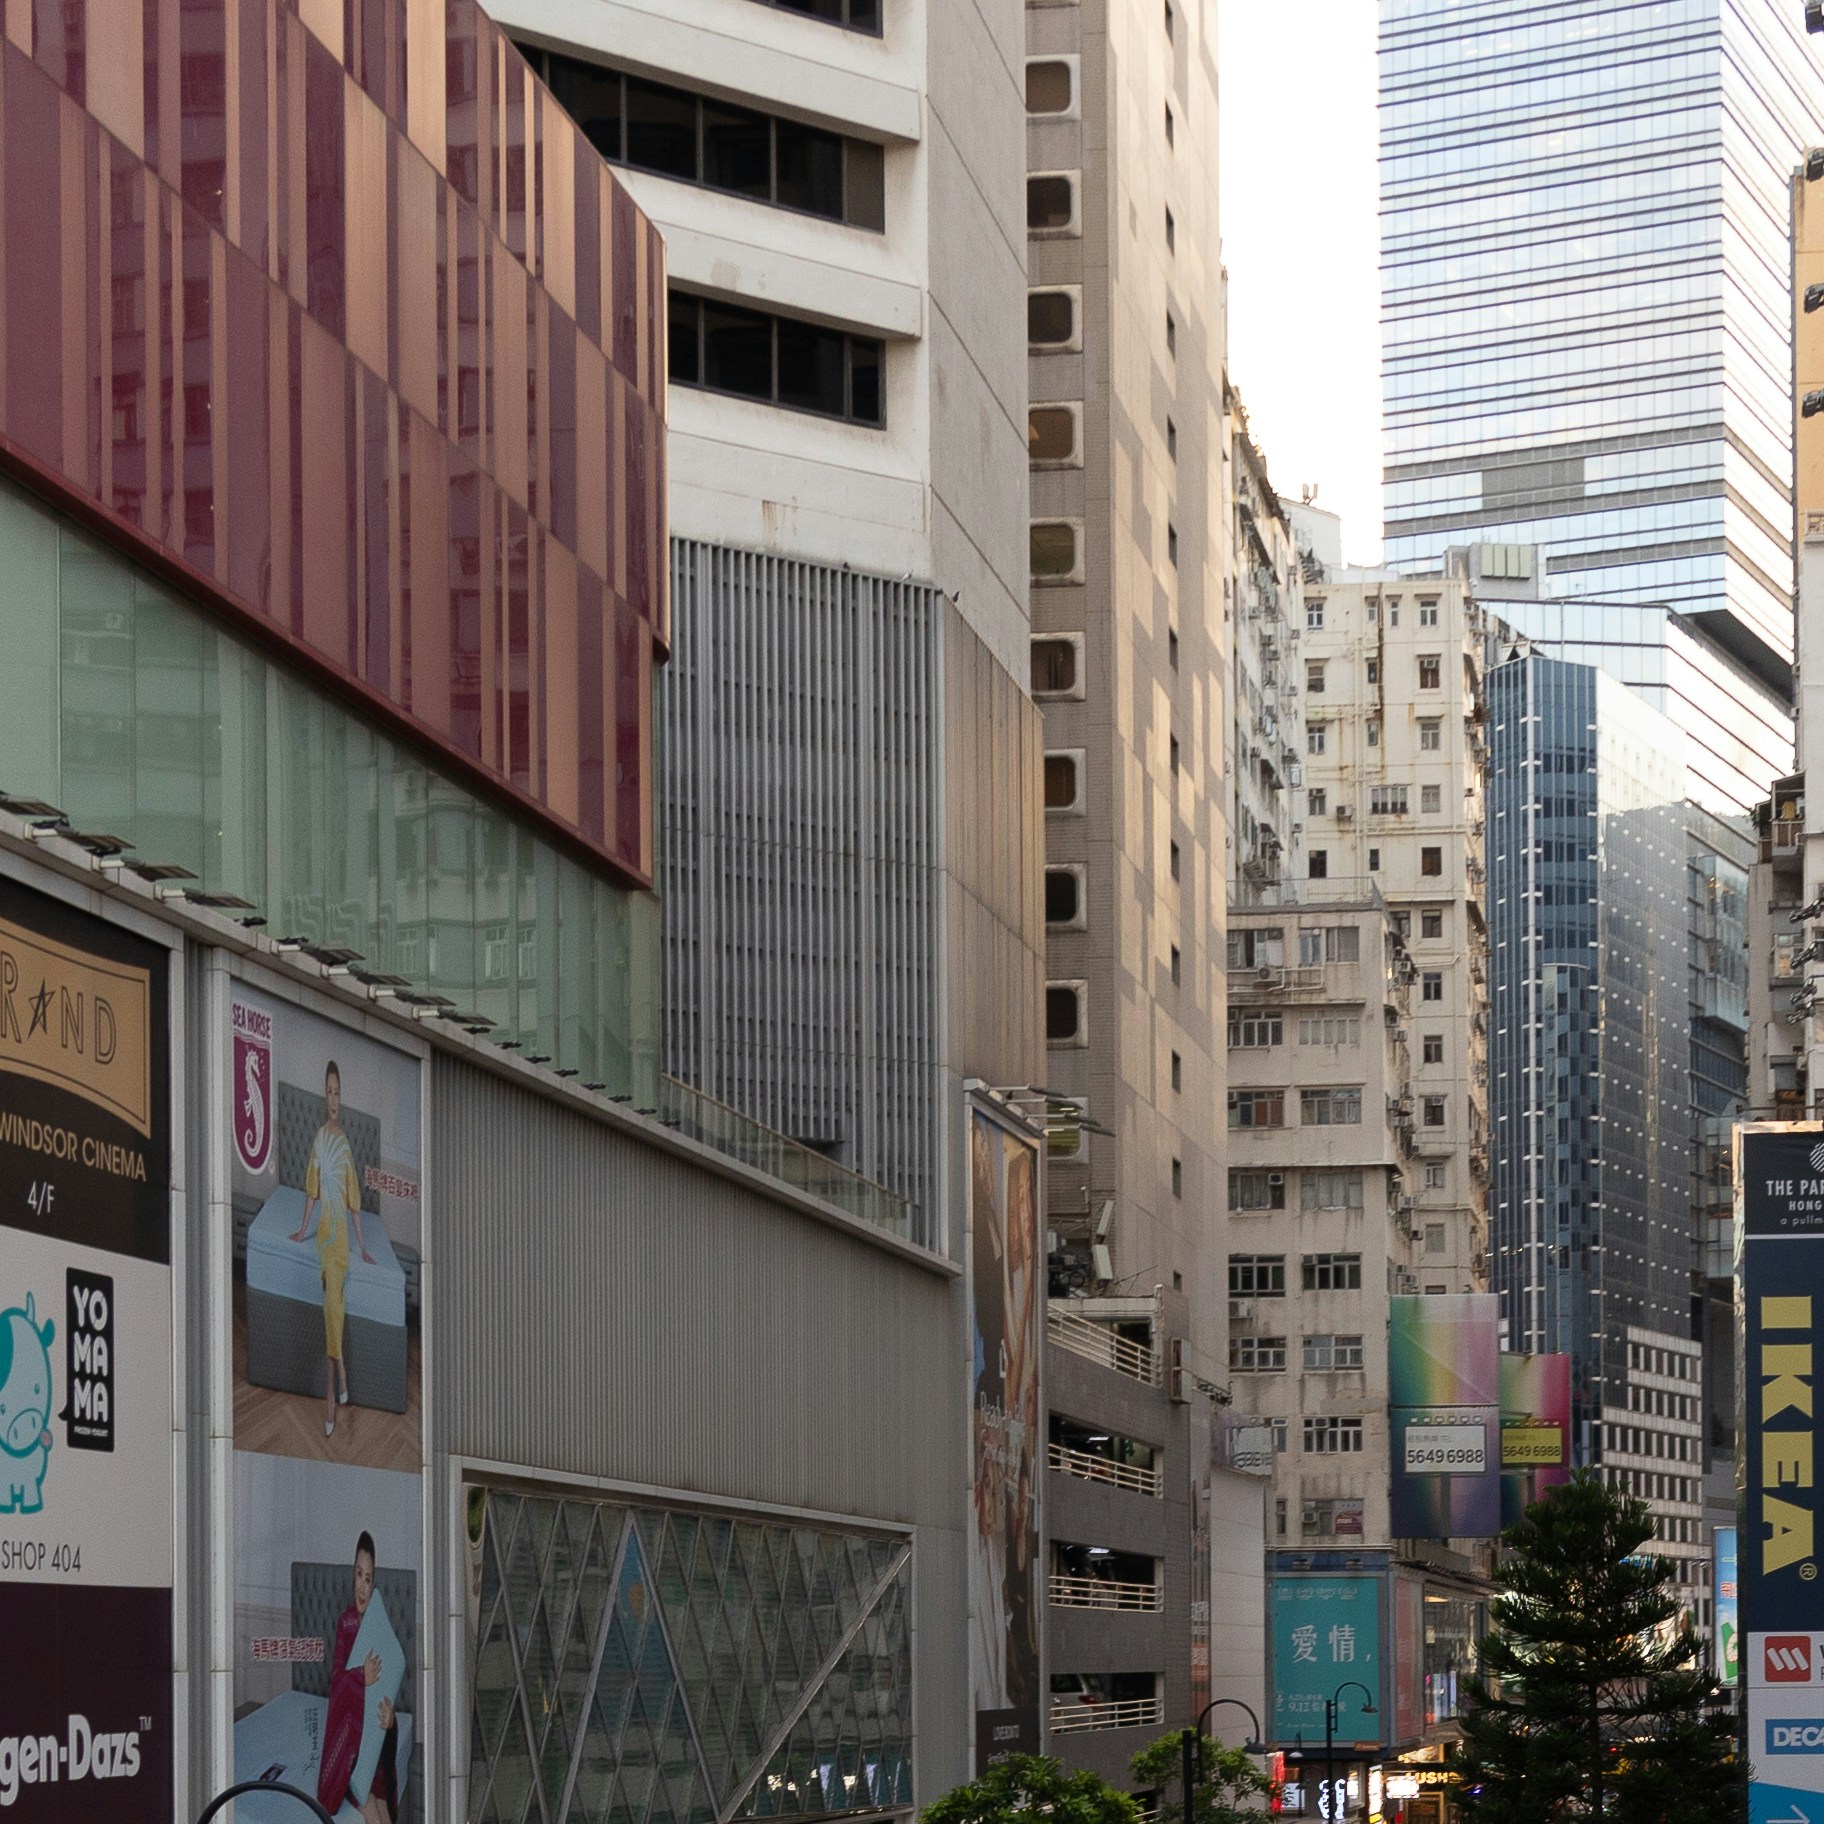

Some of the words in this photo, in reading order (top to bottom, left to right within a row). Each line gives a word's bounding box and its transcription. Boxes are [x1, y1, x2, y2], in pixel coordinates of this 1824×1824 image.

[232, 1003, 246, 1030] SEA
[248, 1011, 271, 1039] HORSE
[82, 1137, 147, 1182] CINEMA
[27, 1180, 55, 1215] 4/F
[1766, 1181, 1794, 1196] THE
[1788, 1200, 1822, 1211] HONG
[73, 1284, 108, 1331] YO
[74, 1331, 108, 1377] MA
[74, 1378, 108, 1423] MA
[1503, 1446, 1531, 1457] 5649
[1533, 1446, 1561, 1457] 6988
[1761, 1295, 1814, 1576] IKEA
[1407, 1449, 1444, 1464] 5649
[1447, 1449, 1484, 1464] 6988
[1, 1540, 46, 1571] SHOP
[52, 1544, 81, 1572] 404
